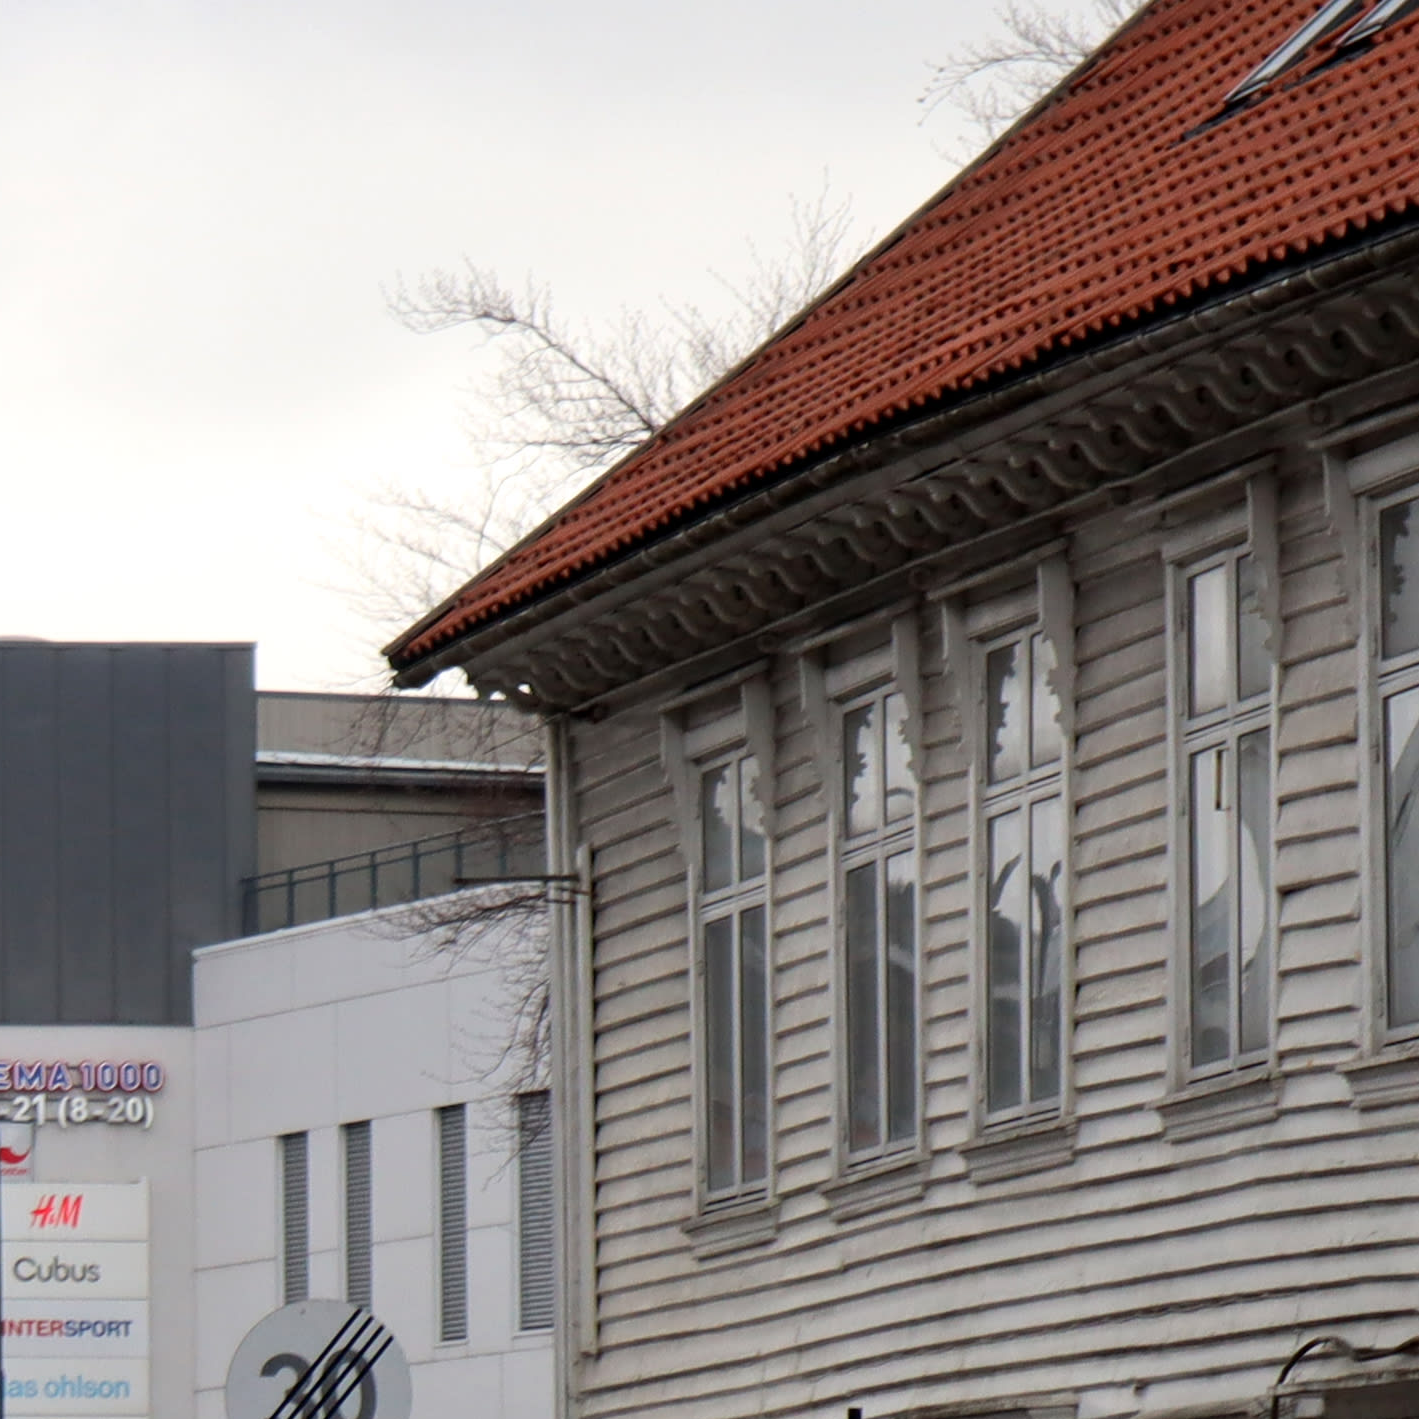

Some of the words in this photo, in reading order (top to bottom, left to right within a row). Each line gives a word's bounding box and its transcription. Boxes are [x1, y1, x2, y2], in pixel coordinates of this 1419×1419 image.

[79, 1060, 164, 1092] 1000
[30, 1194, 83, 1228] H&M
[13, 1256, 101, 1282] Cubus
[0, 1319, 132, 1337] INTERSPORT
[44, 1375, 130, 1400] ohlson
